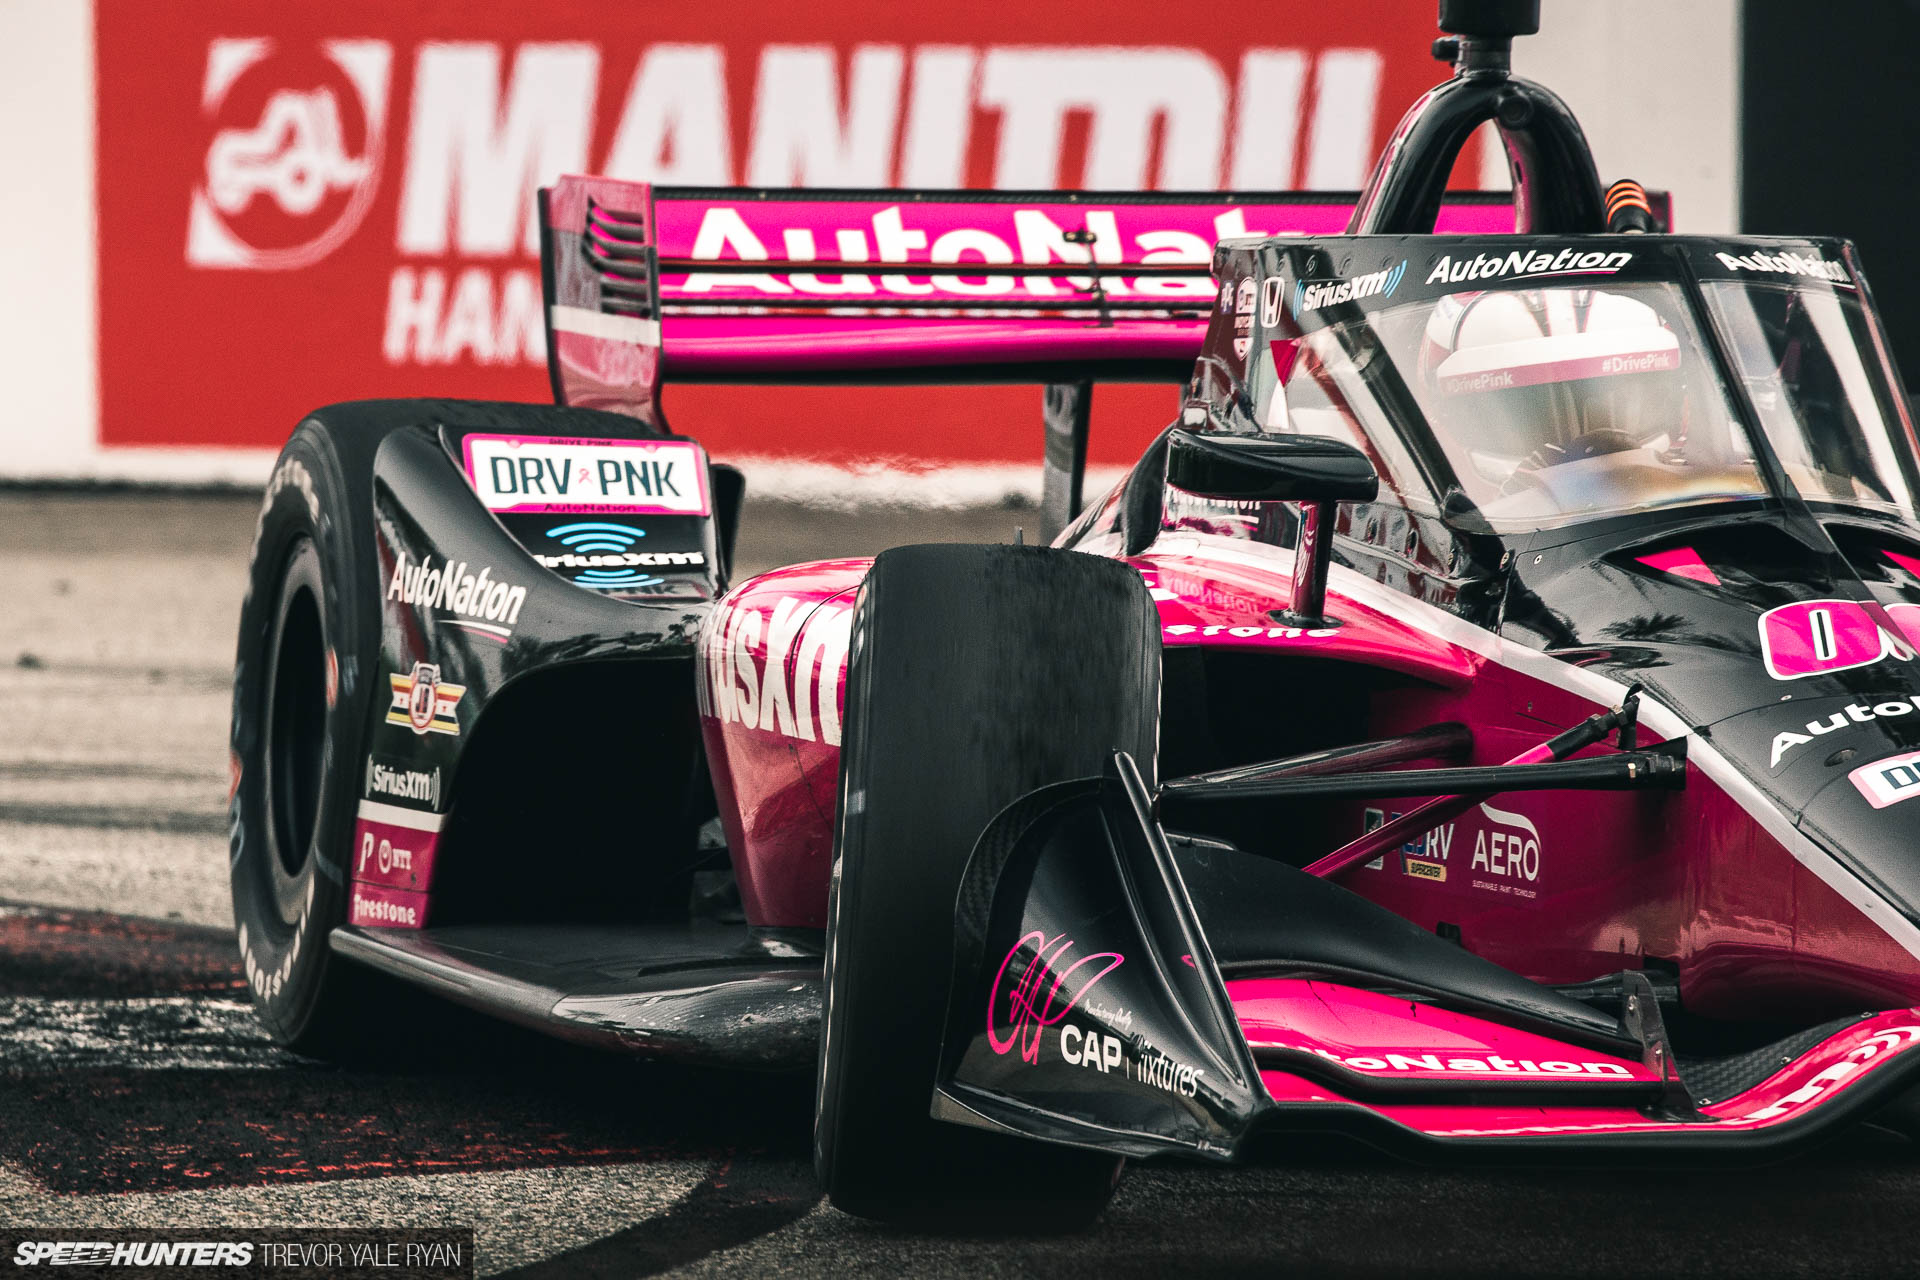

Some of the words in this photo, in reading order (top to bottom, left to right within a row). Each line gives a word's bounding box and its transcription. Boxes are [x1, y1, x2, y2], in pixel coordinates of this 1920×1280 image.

[1425, 247, 1632, 285] AutoNation
[490, 456, 572, 495] DRV
[597, 459, 681, 496] PNK
[387, 551, 526, 625] AutoNation
[1770, 696, 1920, 769] Auto
[1471, 829, 1540, 881] AERO
[1060, 1024, 1122, 1074] CAP
